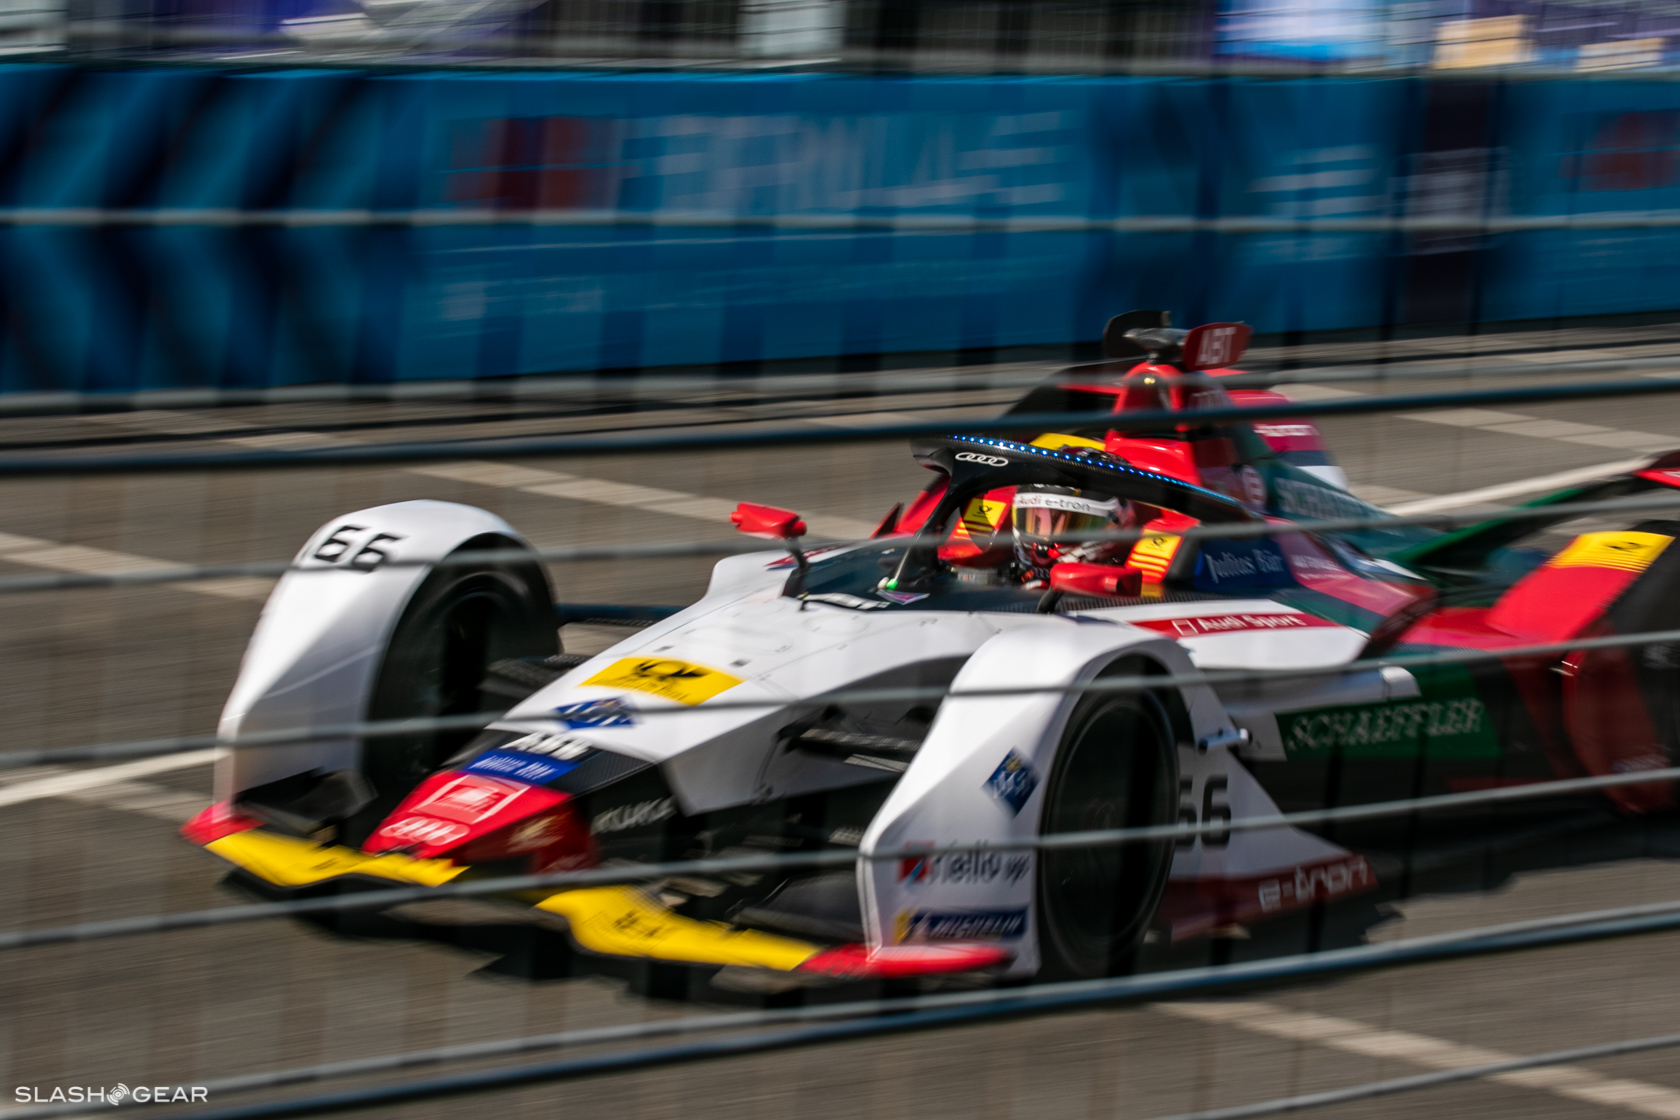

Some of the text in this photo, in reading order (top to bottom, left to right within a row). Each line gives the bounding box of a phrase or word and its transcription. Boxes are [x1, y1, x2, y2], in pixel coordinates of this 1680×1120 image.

[1195, 326, 1237, 366] ABT
[1044, 498, 1092, 512] e-tron
[307, 524, 406, 574] 66
[1198, 614, 1308, 632] Audi Sport
[1286, 697, 1485, 751] SCHAEFFLER
[1258, 856, 1369, 913] e-tron
